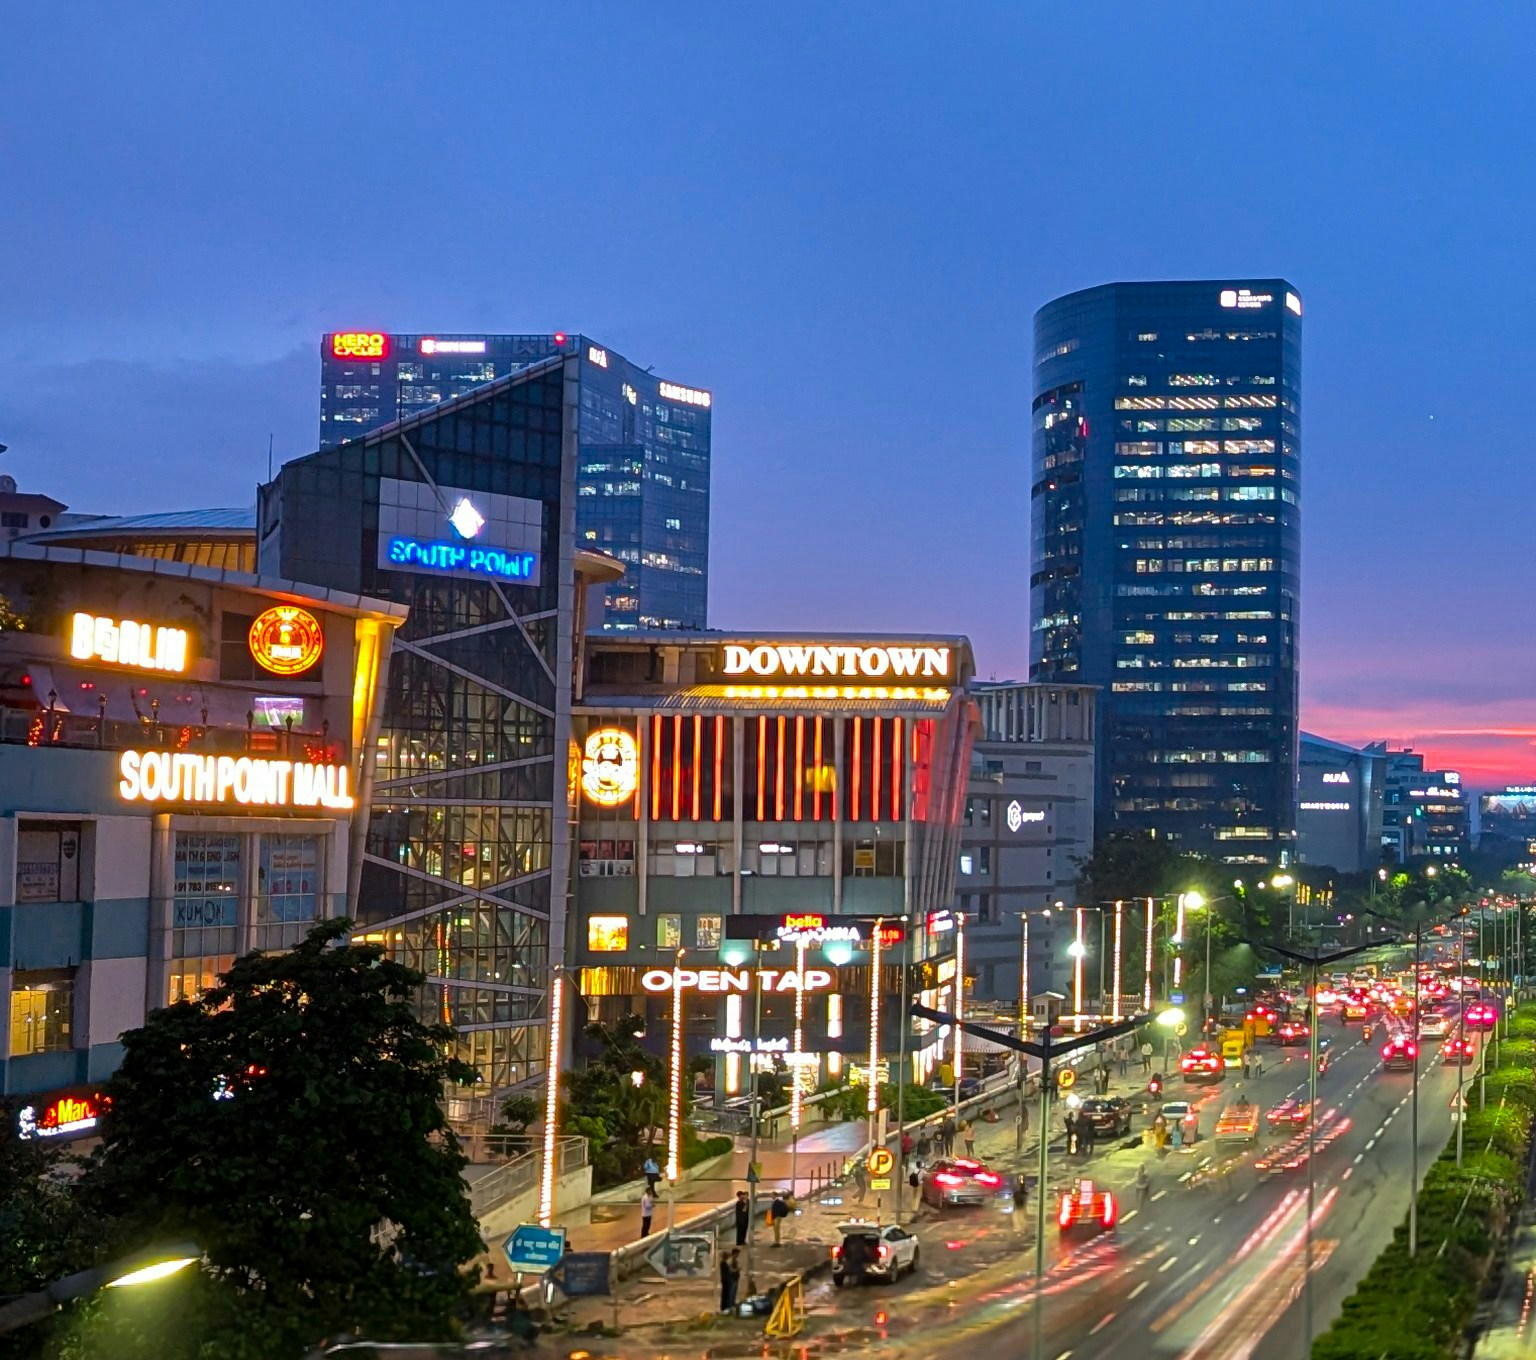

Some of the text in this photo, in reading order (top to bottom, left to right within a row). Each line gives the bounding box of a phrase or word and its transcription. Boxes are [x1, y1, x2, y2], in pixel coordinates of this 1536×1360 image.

[333, 333, 384, 347] HERO
[333, 346, 383, 357] CYCLES
[659, 381, 711, 407] SAMSUNG
[390, 540, 534, 577] SOUTH POINT
[723, 645, 950, 677] DOWNTOWN
[119, 750, 354, 809] SOUTH POINT MALL
[177, 901, 224, 924] KUMON
[785, 915, 823, 928] bella
[641, 969, 832, 991] OPEN TAP
[876, 1154, 890, 1171] P
